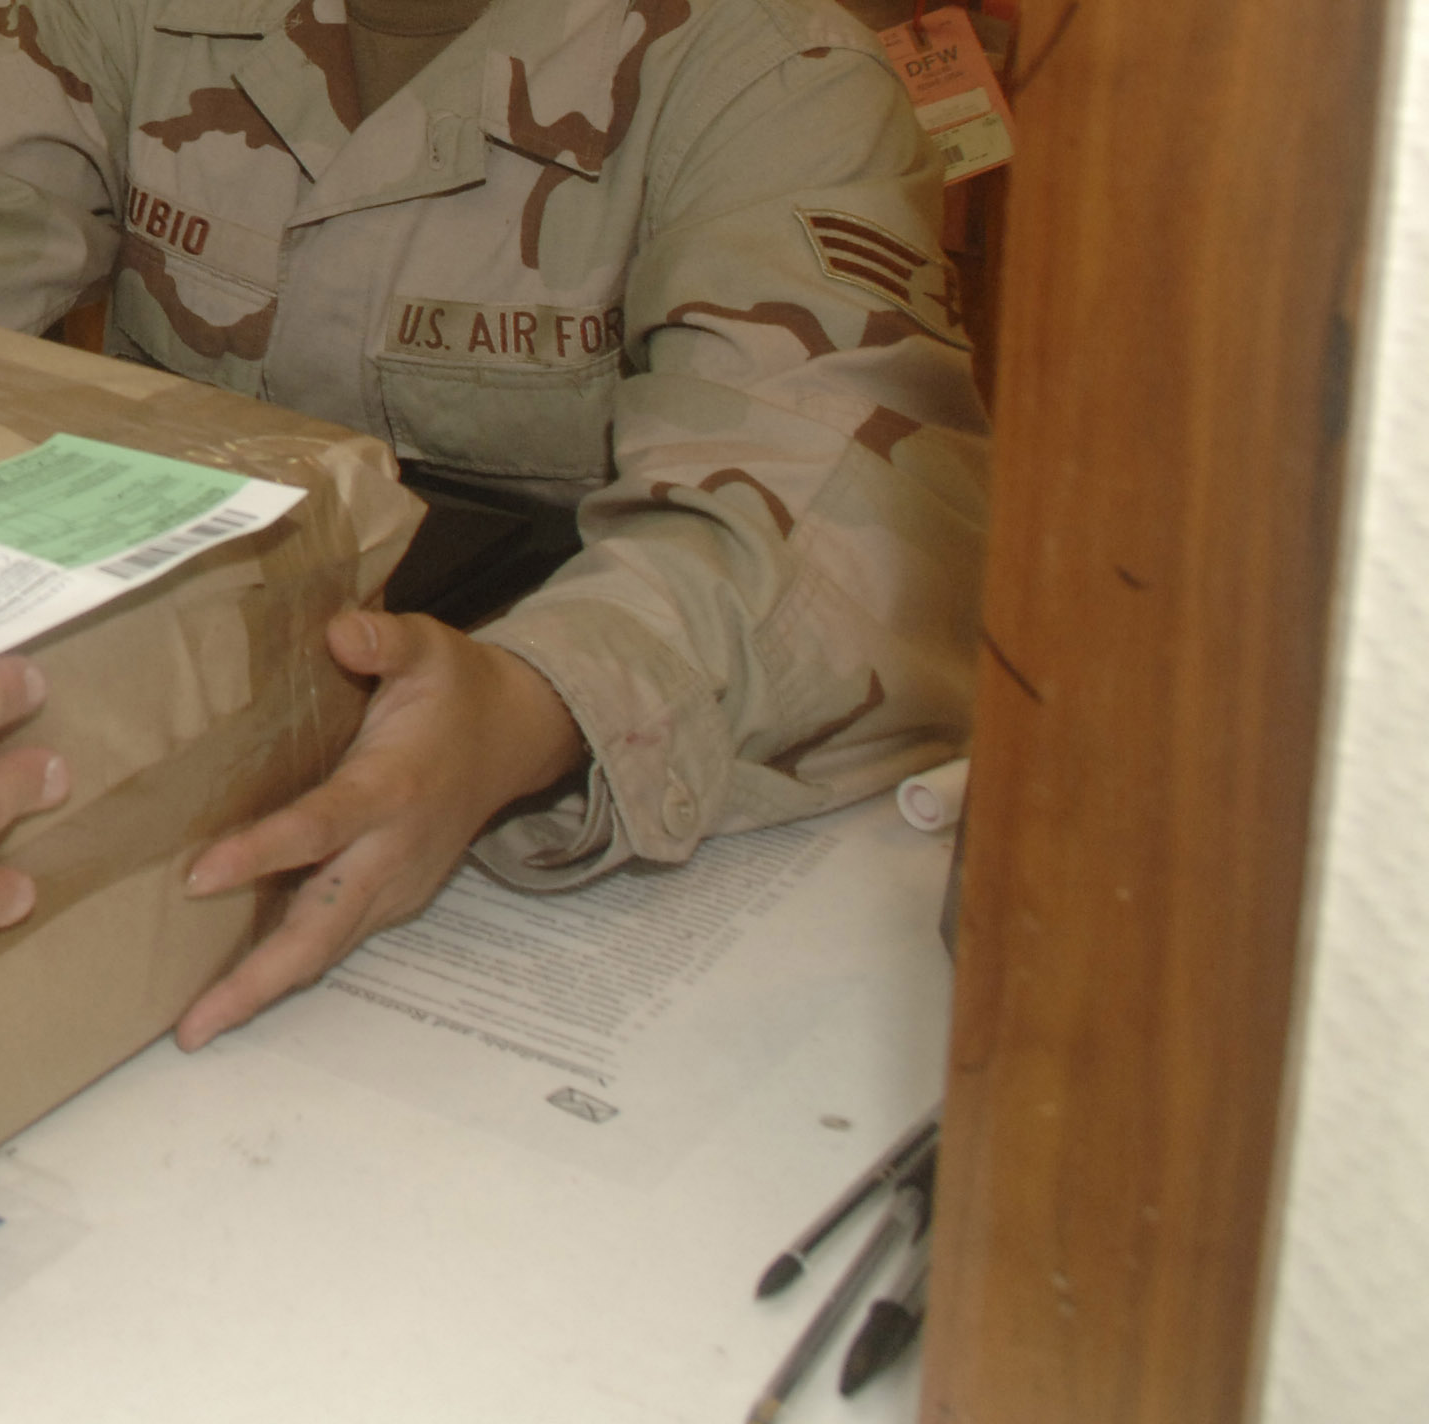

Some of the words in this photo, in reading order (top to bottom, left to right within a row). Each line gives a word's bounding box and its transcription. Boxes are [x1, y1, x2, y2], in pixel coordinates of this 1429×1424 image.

[905, 44, 959, 77] DFW
[129, 186, 211, 256] UBIO
[397, 303, 452, 352] U.S.
[468, 310, 539, 354] AIR
[556, 307, 622, 358] FOR
